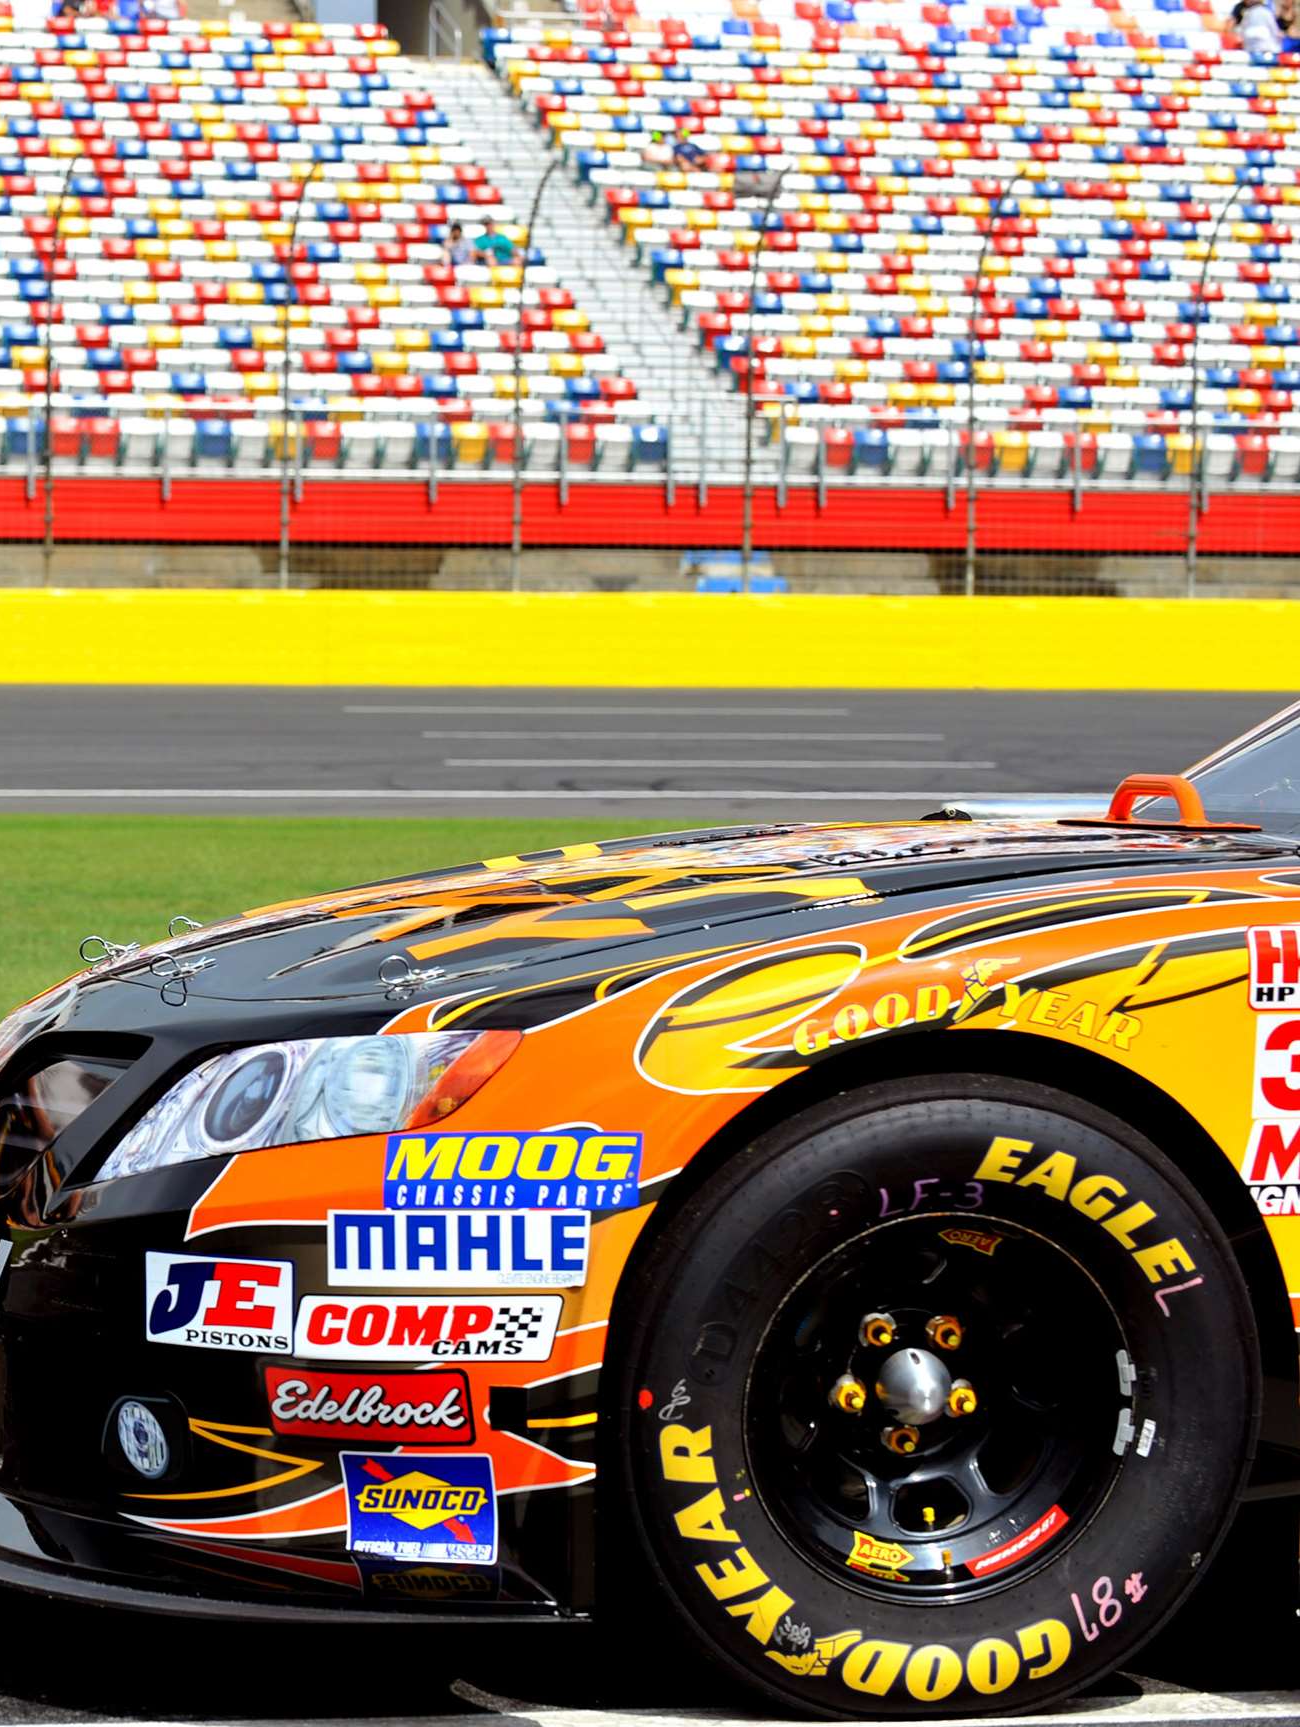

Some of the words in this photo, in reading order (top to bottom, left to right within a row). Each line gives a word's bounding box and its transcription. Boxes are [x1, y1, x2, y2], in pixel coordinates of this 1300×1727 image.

[1256, 986, 1295, 1002] HP
[387, 1135, 637, 1181] MOOG
[396, 1184, 516, 1206] CHASSIS
[537, 1183, 624, 1206] PARTS
[879, 1178, 984, 1217] LF-3
[973, 1135, 1197, 1284] EAGLE
[333, 1213, 587, 1272] MAHLE
[149, 1260, 282, 1335] JE
[185, 1329, 289, 1351] PISTONS
[306, 1303, 494, 1347] COMP
[431, 1339, 524, 1356] CAMS
[271, 1379, 466, 1428] Edelbrock
[363, 1488, 481, 1511] SUNOCO
[858, 1543, 903, 1564] AERO
